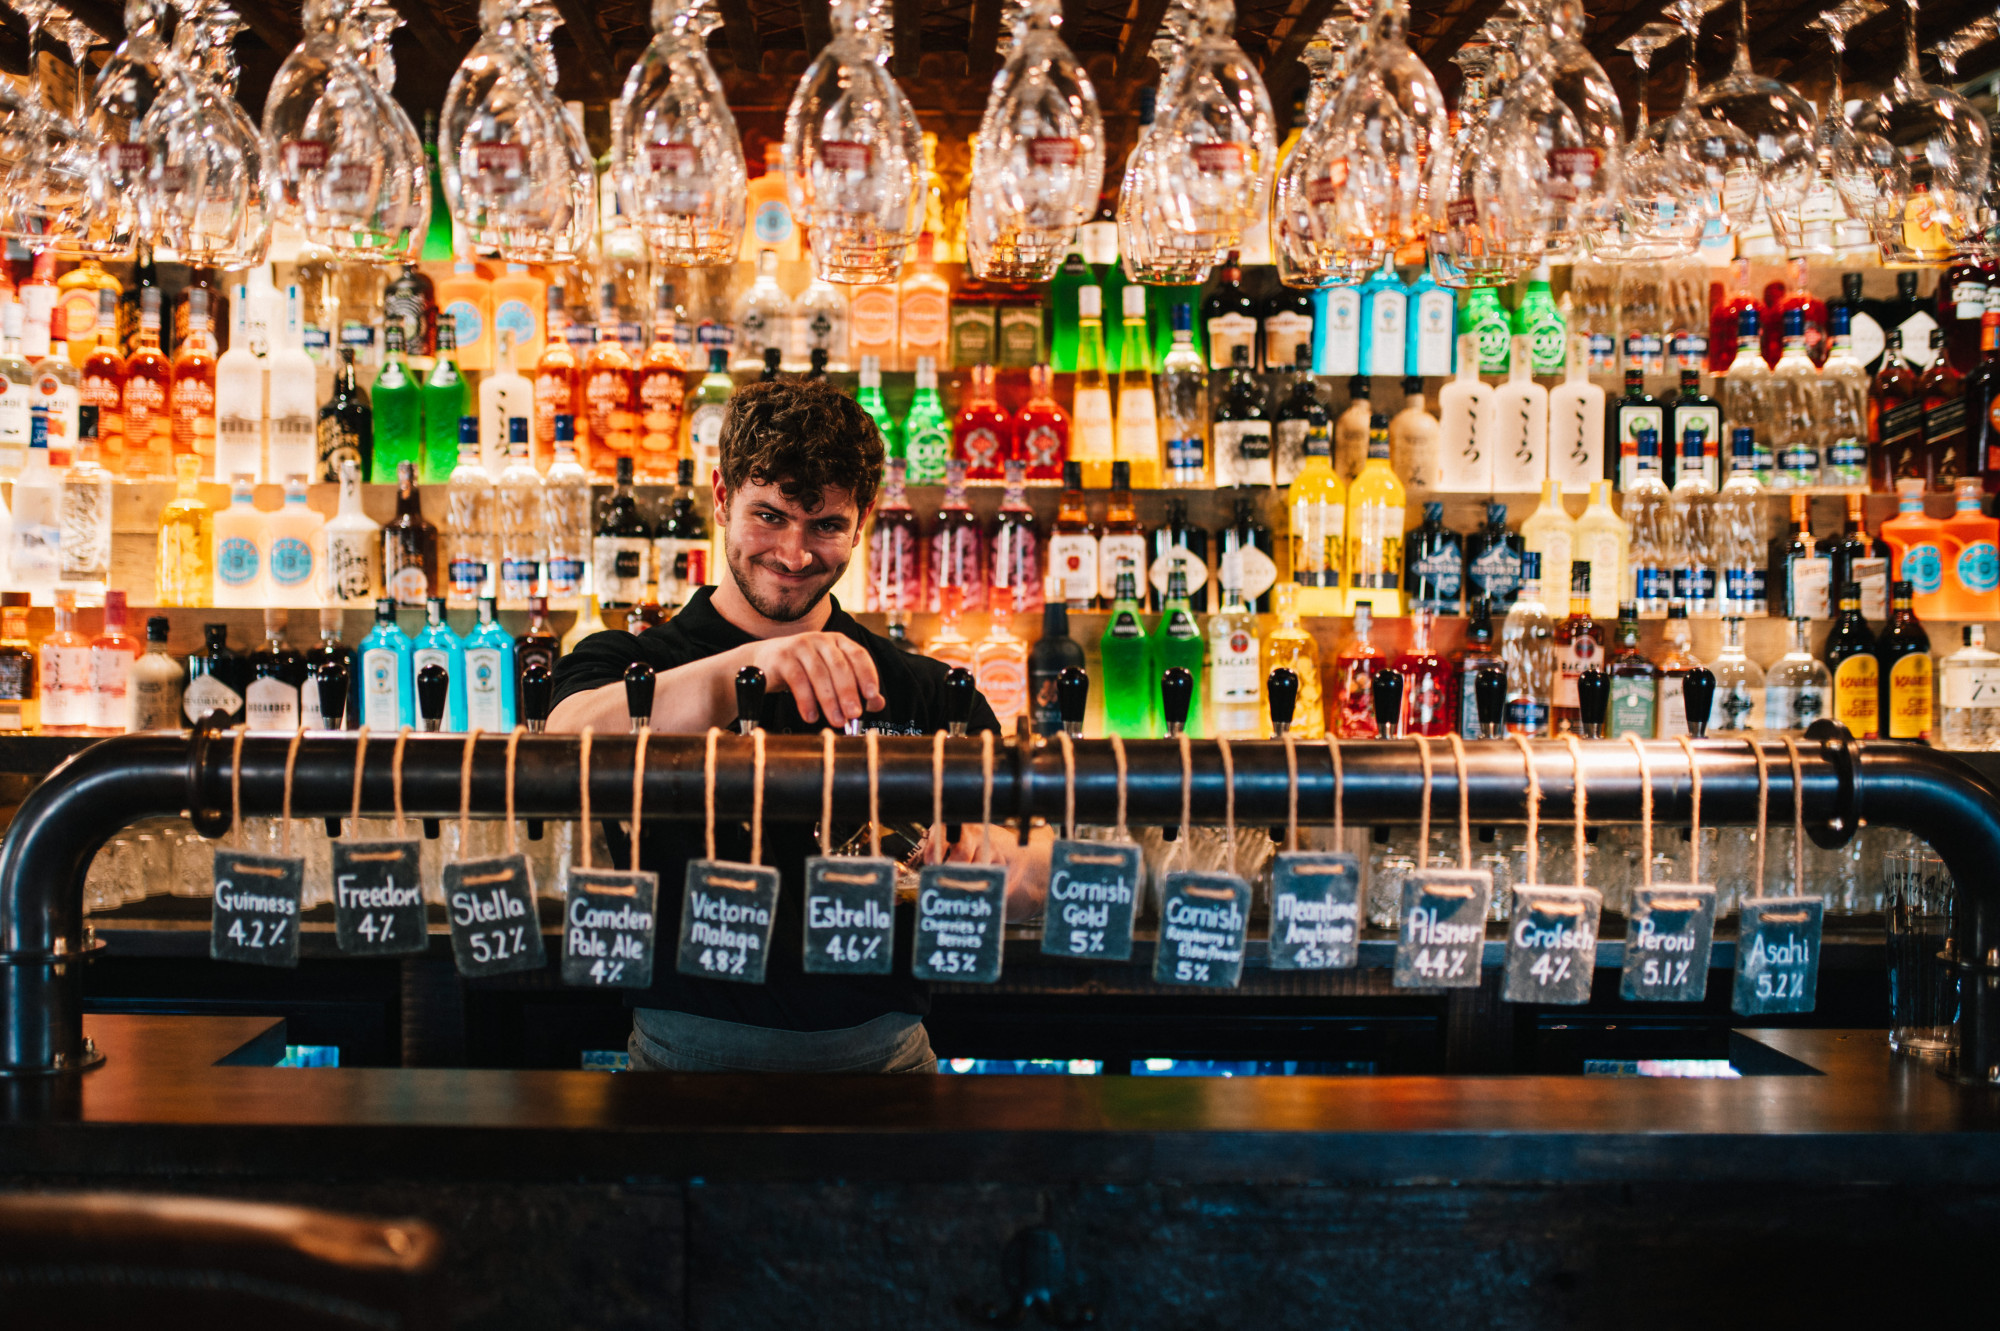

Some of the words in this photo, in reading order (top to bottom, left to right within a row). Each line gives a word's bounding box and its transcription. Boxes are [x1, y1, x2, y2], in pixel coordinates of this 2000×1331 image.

[215, 880, 297, 915] Guinness
[921, 888, 992, 917] Cornish
[1051, 870, 1131, 904] Cornish
[452, 888, 526, 926] Stella
[570, 897, 653, 930] Camden
[691, 890, 770, 926] Victoria
[808, 896, 891, 929] Estrella
[1062, 904, 1109, 928] Gold
[1166, 896, 1242, 931] Cornish
[1277, 893, 1359, 923] Meantime
[227, 918, 288, 948] 4.2%
[357, 912, 395, 943] 4%
[569, 927, 608, 957] Pale
[611, 933, 643, 959] Ale
[691, 921, 761, 957] Malaga
[1069, 930, 1105, 953] 5%
[1284, 919, 1353, 951] Anytime
[1407, 907, 1482, 947] Pilsner
[1514, 918, 1596, 952] Grolsch
[1636, 918, 1696, 952] Peroni
[470, 926, 527, 963] 5.2%
[825, 934, 883, 962] 4.6%
[1749, 933, 1811, 967] Asahi
[589, 959, 625, 985] 4%
[928, 950, 977, 974] 4.5%
[1175, 960, 1210, 981] 5%
[1529, 953, 1571, 986] 4%
[1641, 958, 1690, 988] 5.1%
[1756, 972, 1804, 999] 5.2%
